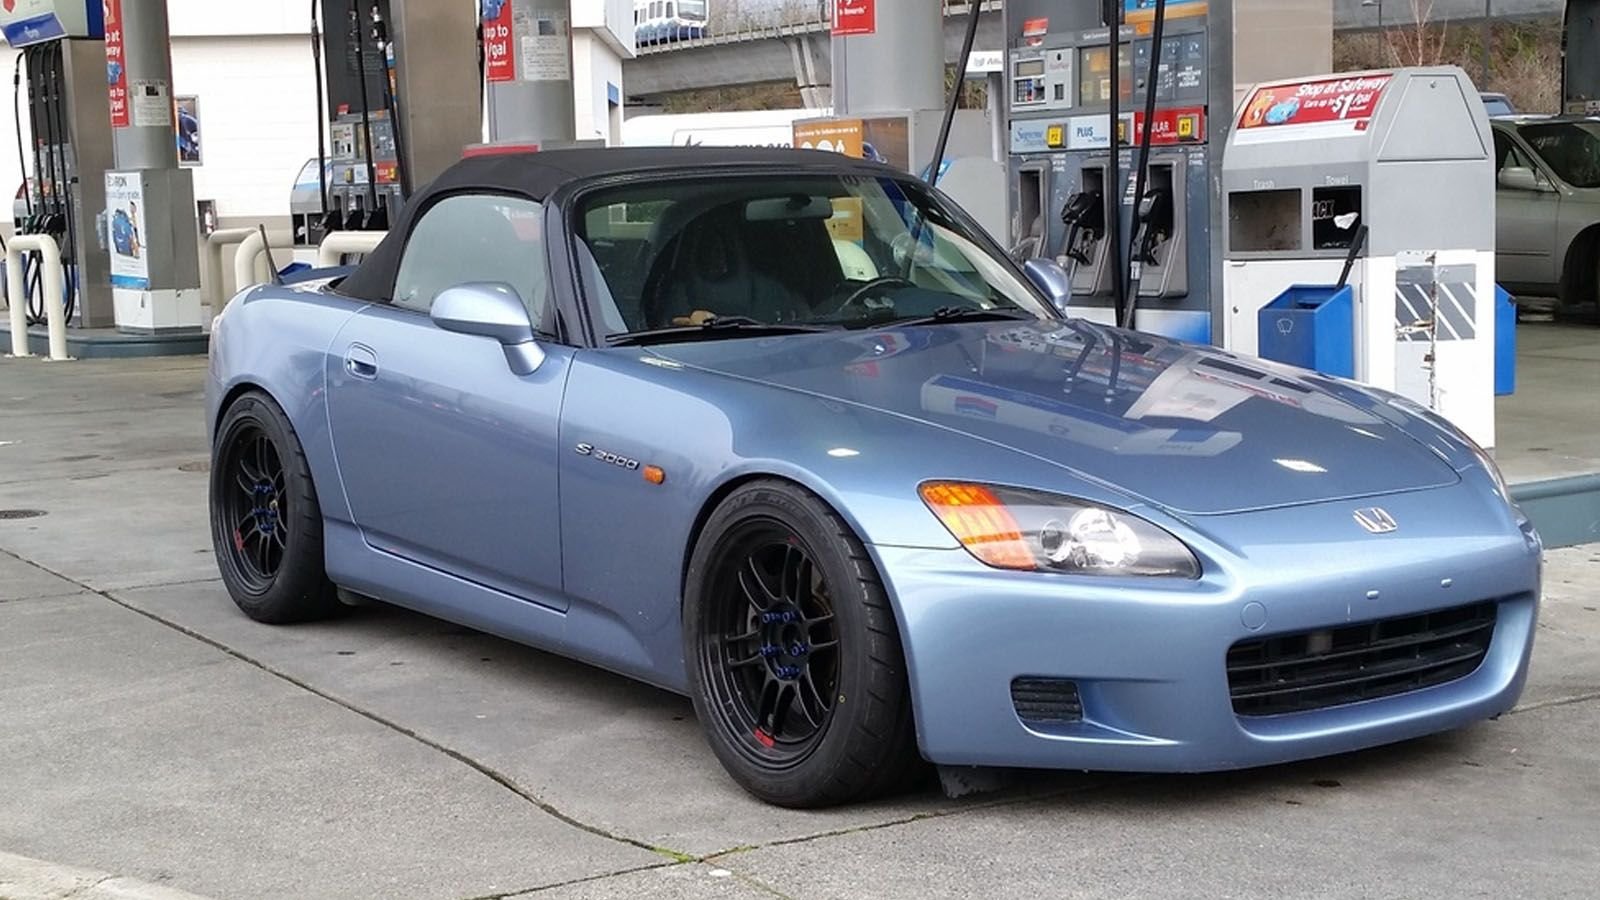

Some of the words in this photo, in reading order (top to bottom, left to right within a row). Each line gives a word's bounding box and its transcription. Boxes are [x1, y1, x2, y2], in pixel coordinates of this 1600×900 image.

[497, 24, 508, 37] to
[1296, 83, 1323, 98] Shop
[1324, 80, 1339, 93] at
[1339, 77, 1388, 92] Safeway
[1332, 93, 1355, 119] $1
[1077, 126, 1094, 137] PLUS
[1253, 179, 1275, 189] Trash
[1325, 174, 1349, 186] Towel
